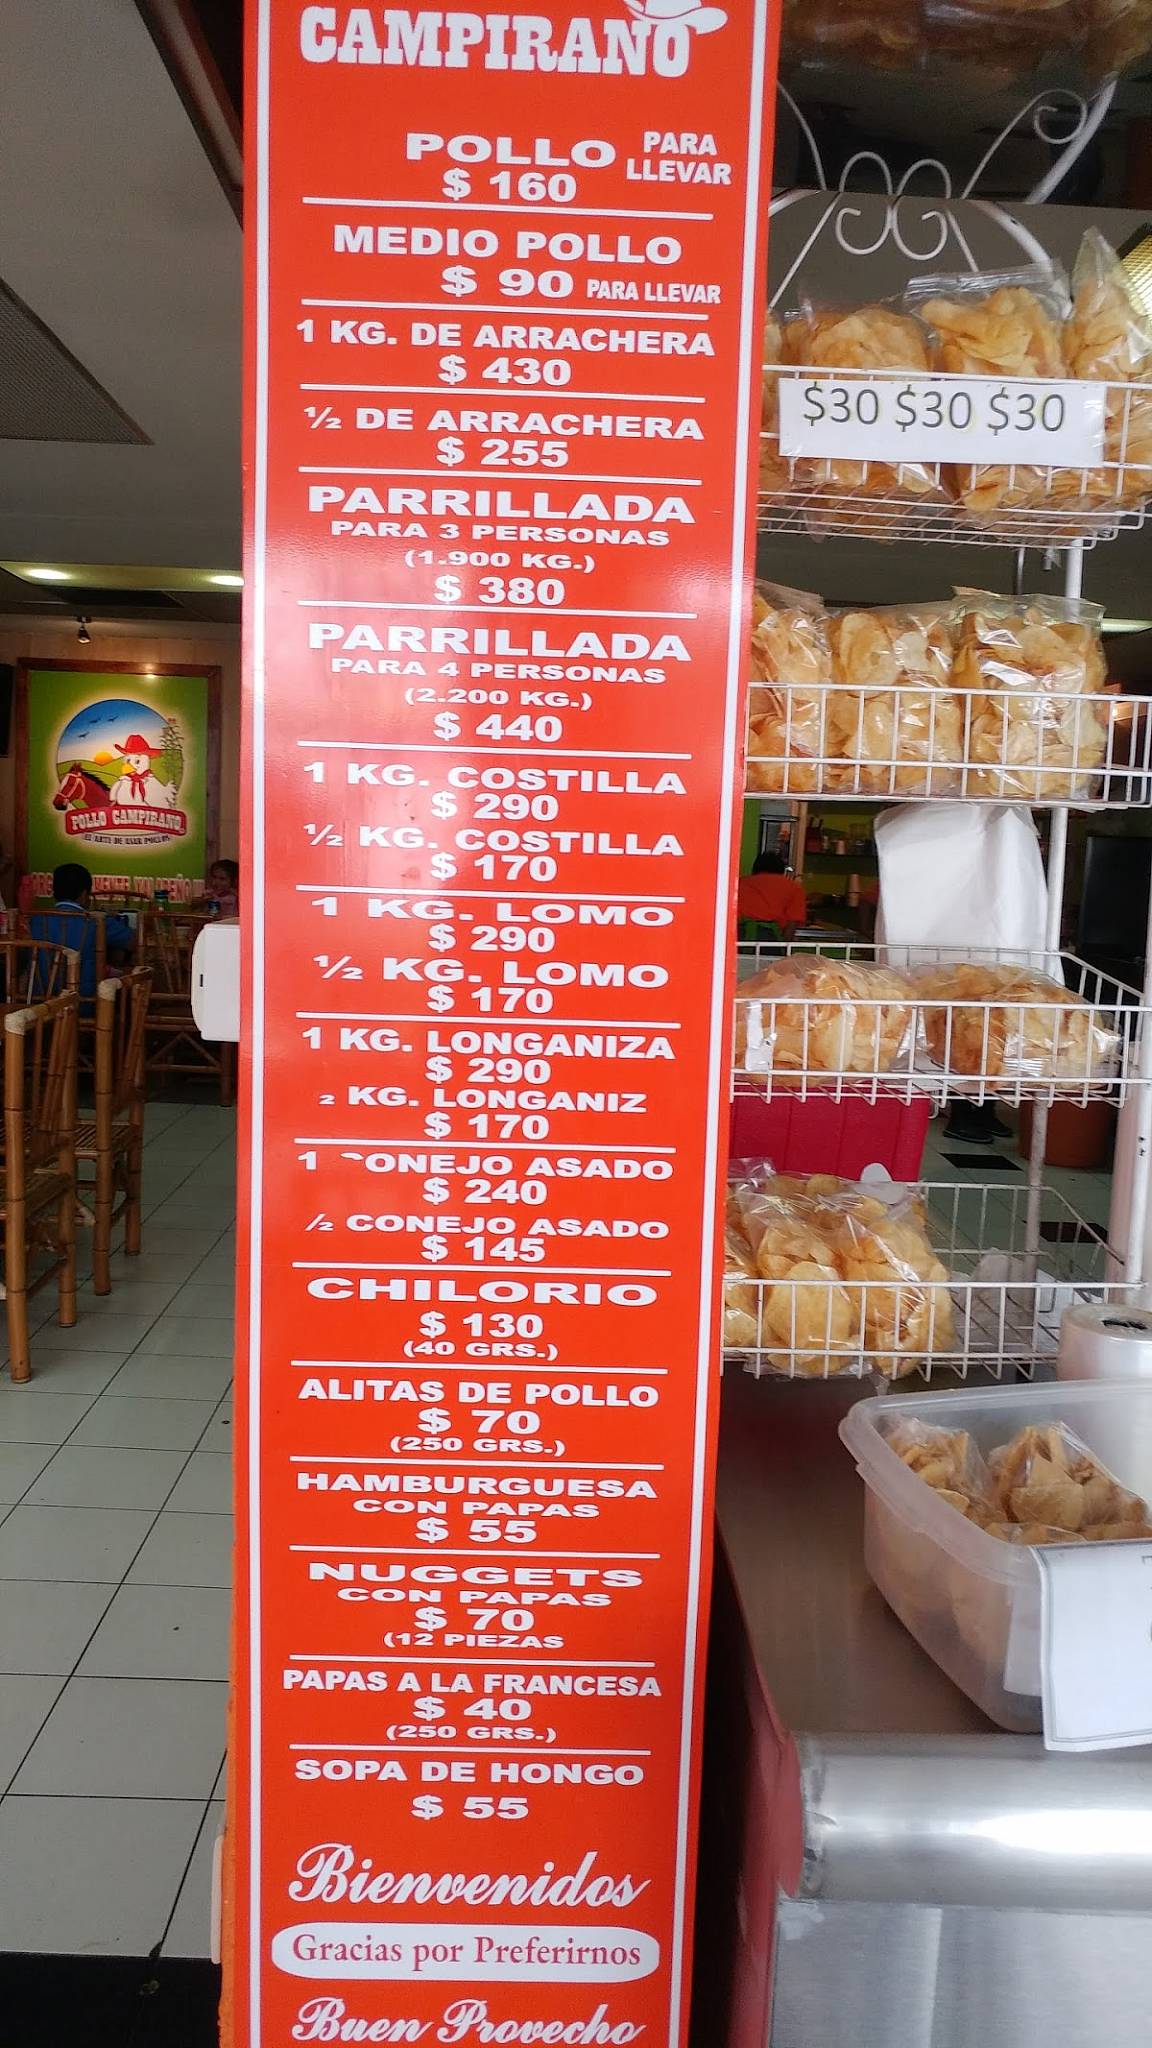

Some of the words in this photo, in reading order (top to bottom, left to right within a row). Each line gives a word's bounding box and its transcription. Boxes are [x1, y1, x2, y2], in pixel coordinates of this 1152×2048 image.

[301, 6, 691, 77] CAMPIRANO
[407, 133, 615, 167] POLLO
[644, 131, 717, 155] PARA
[443, 168, 470, 200] $
[490, 171, 576, 202] 160
[627, 158, 731, 185] LLEVAR
[335, 225, 498, 257] MEDIO
[517, 232, 681, 264] POLLO
[441, 265, 477, 297] $
[499, 269, 573, 297] 90
[587, 279, 638, 300] PARA
[645, 283, 720, 304] LLEVAR
[297, 319, 313, 342] 1
[331, 320, 396, 344] KG.
[412, 323, 461, 346] DE
[474, 325, 715, 356] ARRACHERA
[439, 355, 466, 385] $
[483, 357, 571, 385] 430
[803, 381, 879, 426] $30
[895, 384, 972, 432] $30
[987, 387, 1064, 436] $30
[357, 408, 413, 430] DE
[428, 410, 703, 440] ARRACHERA
[437, 436, 464, 466] $
[481, 439, 568, 467] 255
[309, 486, 694, 523] PARRILLADA
[332, 521, 427, 537] PARA
[440, 524, 459, 538] 3
[472, 525, 669, 545] PERSONAS
[405, 549, 510, 570] (1.900
[522, 553, 594, 573] KG.)
[433, 575, 462, 604] $
[479, 576, 564, 605] 380
[309, 624, 691, 662] PARRILLADA
[332, 657, 426, 675] PARA
[437, 662, 459, 676] 4
[471, 663, 665, 683] PERSONAS
[405, 687, 509, 706] (2.200
[520, 691, 591, 710] KG.)
[434, 711, 460, 741] $
[476, 714, 562, 742] 440
[304, 761, 324, 783] 1
[348, 763, 430, 787] KG.
[449, 764, 686, 794] COSTILLA
[71, 811, 107, 830] POLLO
[112, 809, 181, 830] CAMPIRANO
[431, 791, 457, 819] $
[473, 793, 558, 820] 290
[360, 826, 438, 849] KG.
[457, 828, 683, 856] COSTILLA
[429, 852, 456, 880] $
[475, 854, 556, 881] 170
[312, 897, 337, 915] 1
[368, 900, 473, 920] KG.
[497, 903, 673, 926] LOMO
[428, 924, 455, 952] $
[471, 926, 554, 952] 290
[384, 958, 481, 982] KG.
[504, 961, 668, 987] LOMO
[427, 985, 454, 1013] $
[472, 987, 553, 1013] 170
[303, 1027, 320, 1049] 1
[340, 1028, 412, 1052] KG.
[428, 1031, 674, 1059] LONGANIZA
[426, 1056, 452, 1084] $
[468, 1058, 551, 1084] 290
[349, 1086, 418, 1106] KG.
[434, 1088, 646, 1112] LONGANIZ
[424, 1112, 452, 1140] $
[468, 1114, 549, 1139] 170
[299, 1151, 316, 1170] 1
[341, 1152, 512, 1175] ONEJO
[525, 1157, 672, 1179] ASADO
[423, 1177, 449, 1205] $
[465, 1179, 547, 1204] 240
[347, 1215, 515, 1234] CONEJO
[529, 1219, 668, 1238] ASADO
[421, 1235, 448, 1262] $
[465, 1237, 544, 1262] 145
[308, 1278, 656, 1306] CHILORIO
[420, 1311, 445, 1338] $
[463, 1313, 543, 1338] 130
[404, 1341, 455, 1357] (40
[466, 1343, 558, 1360] GRS.)
[299, 1379, 444, 1402] ALITAS
[459, 1382, 511, 1403] DE
[526, 1384, 658, 1407] POLLO
[418, 1408, 451, 1434] $
[472, 1410, 540, 1434] 70
[391, 1437, 462, 1453] (250
[474, 1439, 565, 1456] GRS.)
[298, 1473, 657, 1498] HAMBURGUESA
[354, 1499, 446, 1514] CON
[463, 1502, 599, 1517] PAPAS
[416, 1517, 448, 1543] $
[469, 1520, 536, 1543] 55
[310, 1563, 642, 1587] NUGGETS
[338, 1588, 441, 1602] CON
[460, 1591, 611, 1606] PAPAS
[415, 1606, 447, 1631] $
[467, 1609, 534, 1631] 70
[384, 1632, 433, 1647] (12
[445, 1634, 563, 1648] PIEZAS
[283, 1670, 387, 1691] PAPAS
[398, 1673, 420, 1692] A
[432, 1673, 473, 1693] LA
[484, 1674, 661, 1696] FRANCESA
[413, 1696, 445, 1721] $
[464, 1699, 531, 1720] 40
[387, 1725, 456, 1740] (250
[467, 1727, 556, 1743] GRS.)
[296, 1760, 407, 1781] SOPA
[422, 1762, 475, 1782] DE
[491, 1763, 643, 1785] HONGO
[412, 1795, 443, 1820] $
[463, 1797, 528, 1819] 55
[288, 1843, 650, 1907] Bienvenidos
[292, 1933, 402, 1964] Gracias
[414, 1941, 463, 1971] por
[475, 1936, 641, 1966] Preferirnos
[292, 1997, 432, 2042] Buen
[441, 1999, 645, 2044] Provecho
